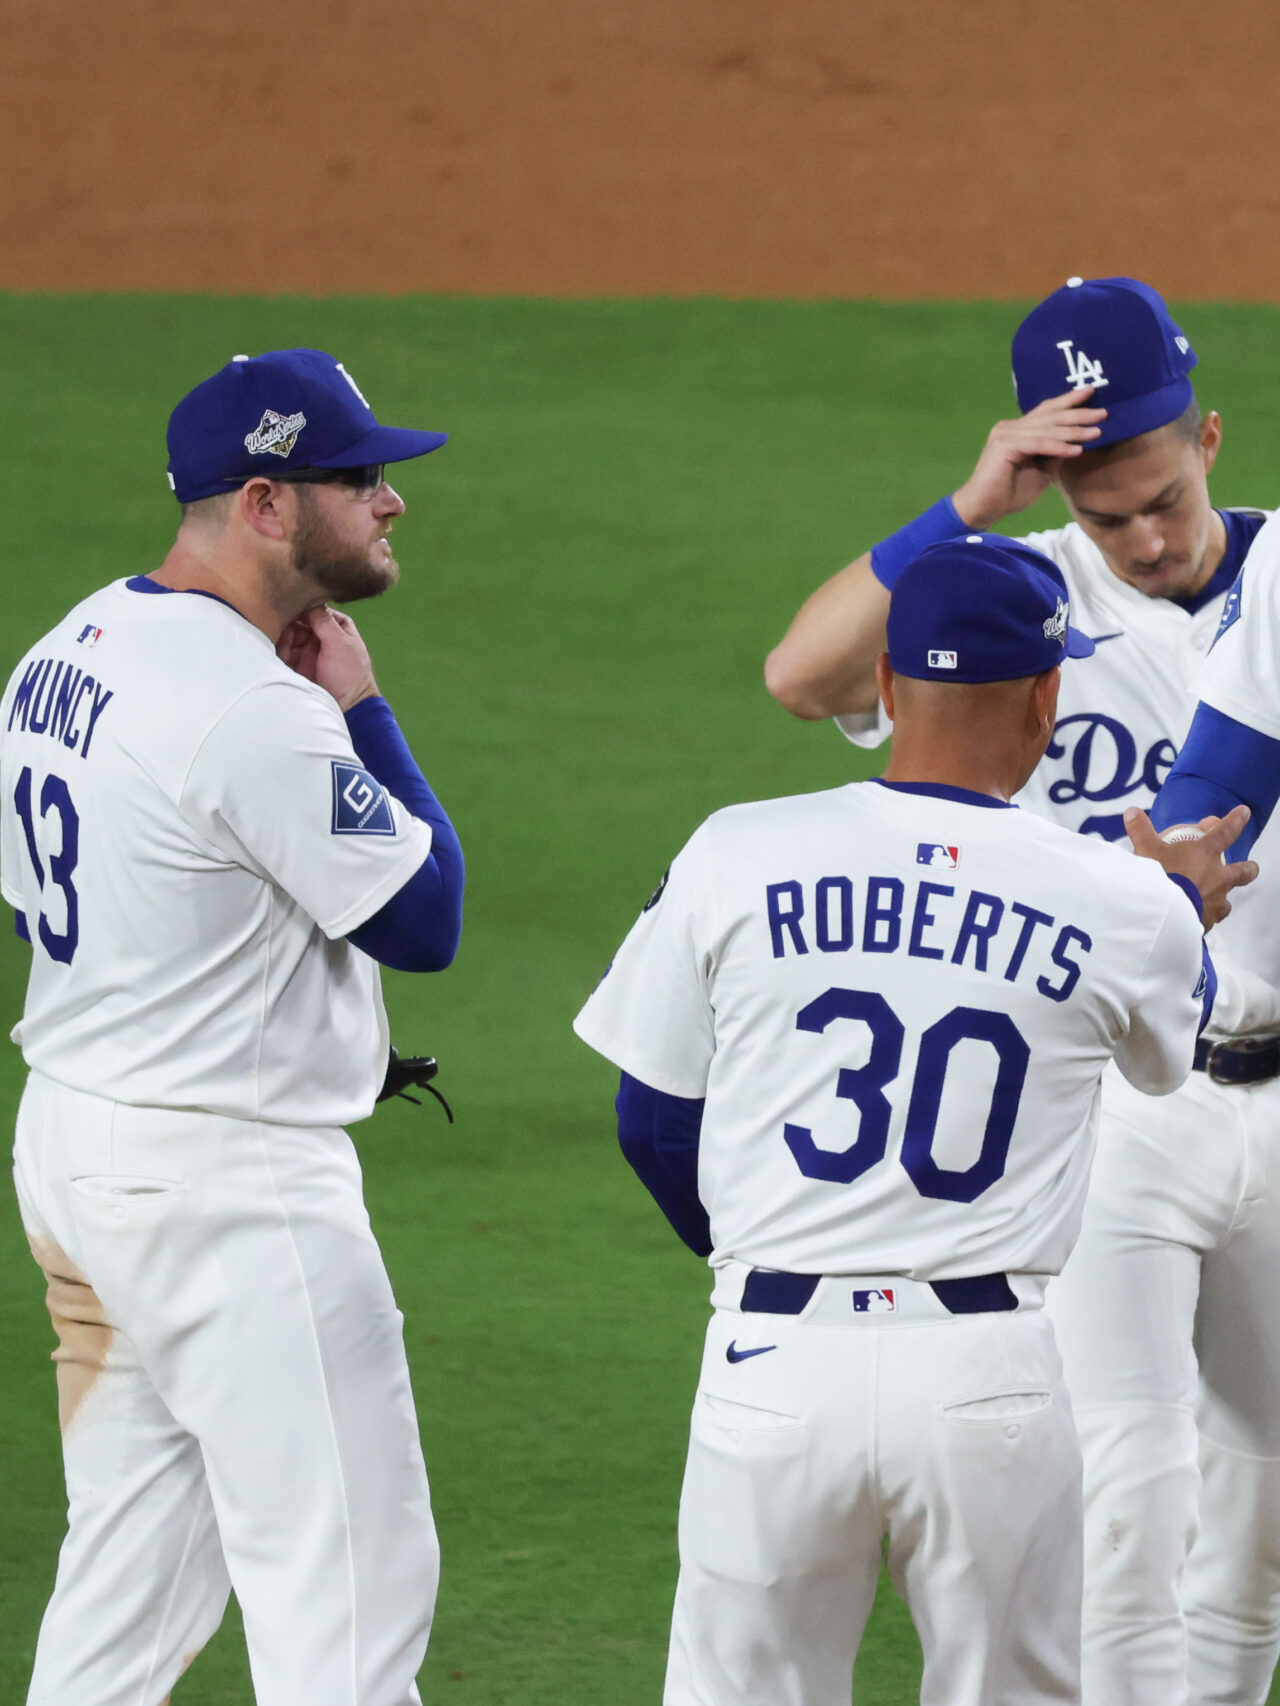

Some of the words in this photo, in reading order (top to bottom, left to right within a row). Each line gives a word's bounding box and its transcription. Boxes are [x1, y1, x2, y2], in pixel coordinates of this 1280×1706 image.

[1057, 340, 1108, 391] LA
[246, 425, 279, 450] World
[8, 659, 114, 759] MUNCY
[14, 766, 79, 965] 13
[766, 876, 1092, 1003] ROBERTS
[783, 987, 1031, 1204] 30
